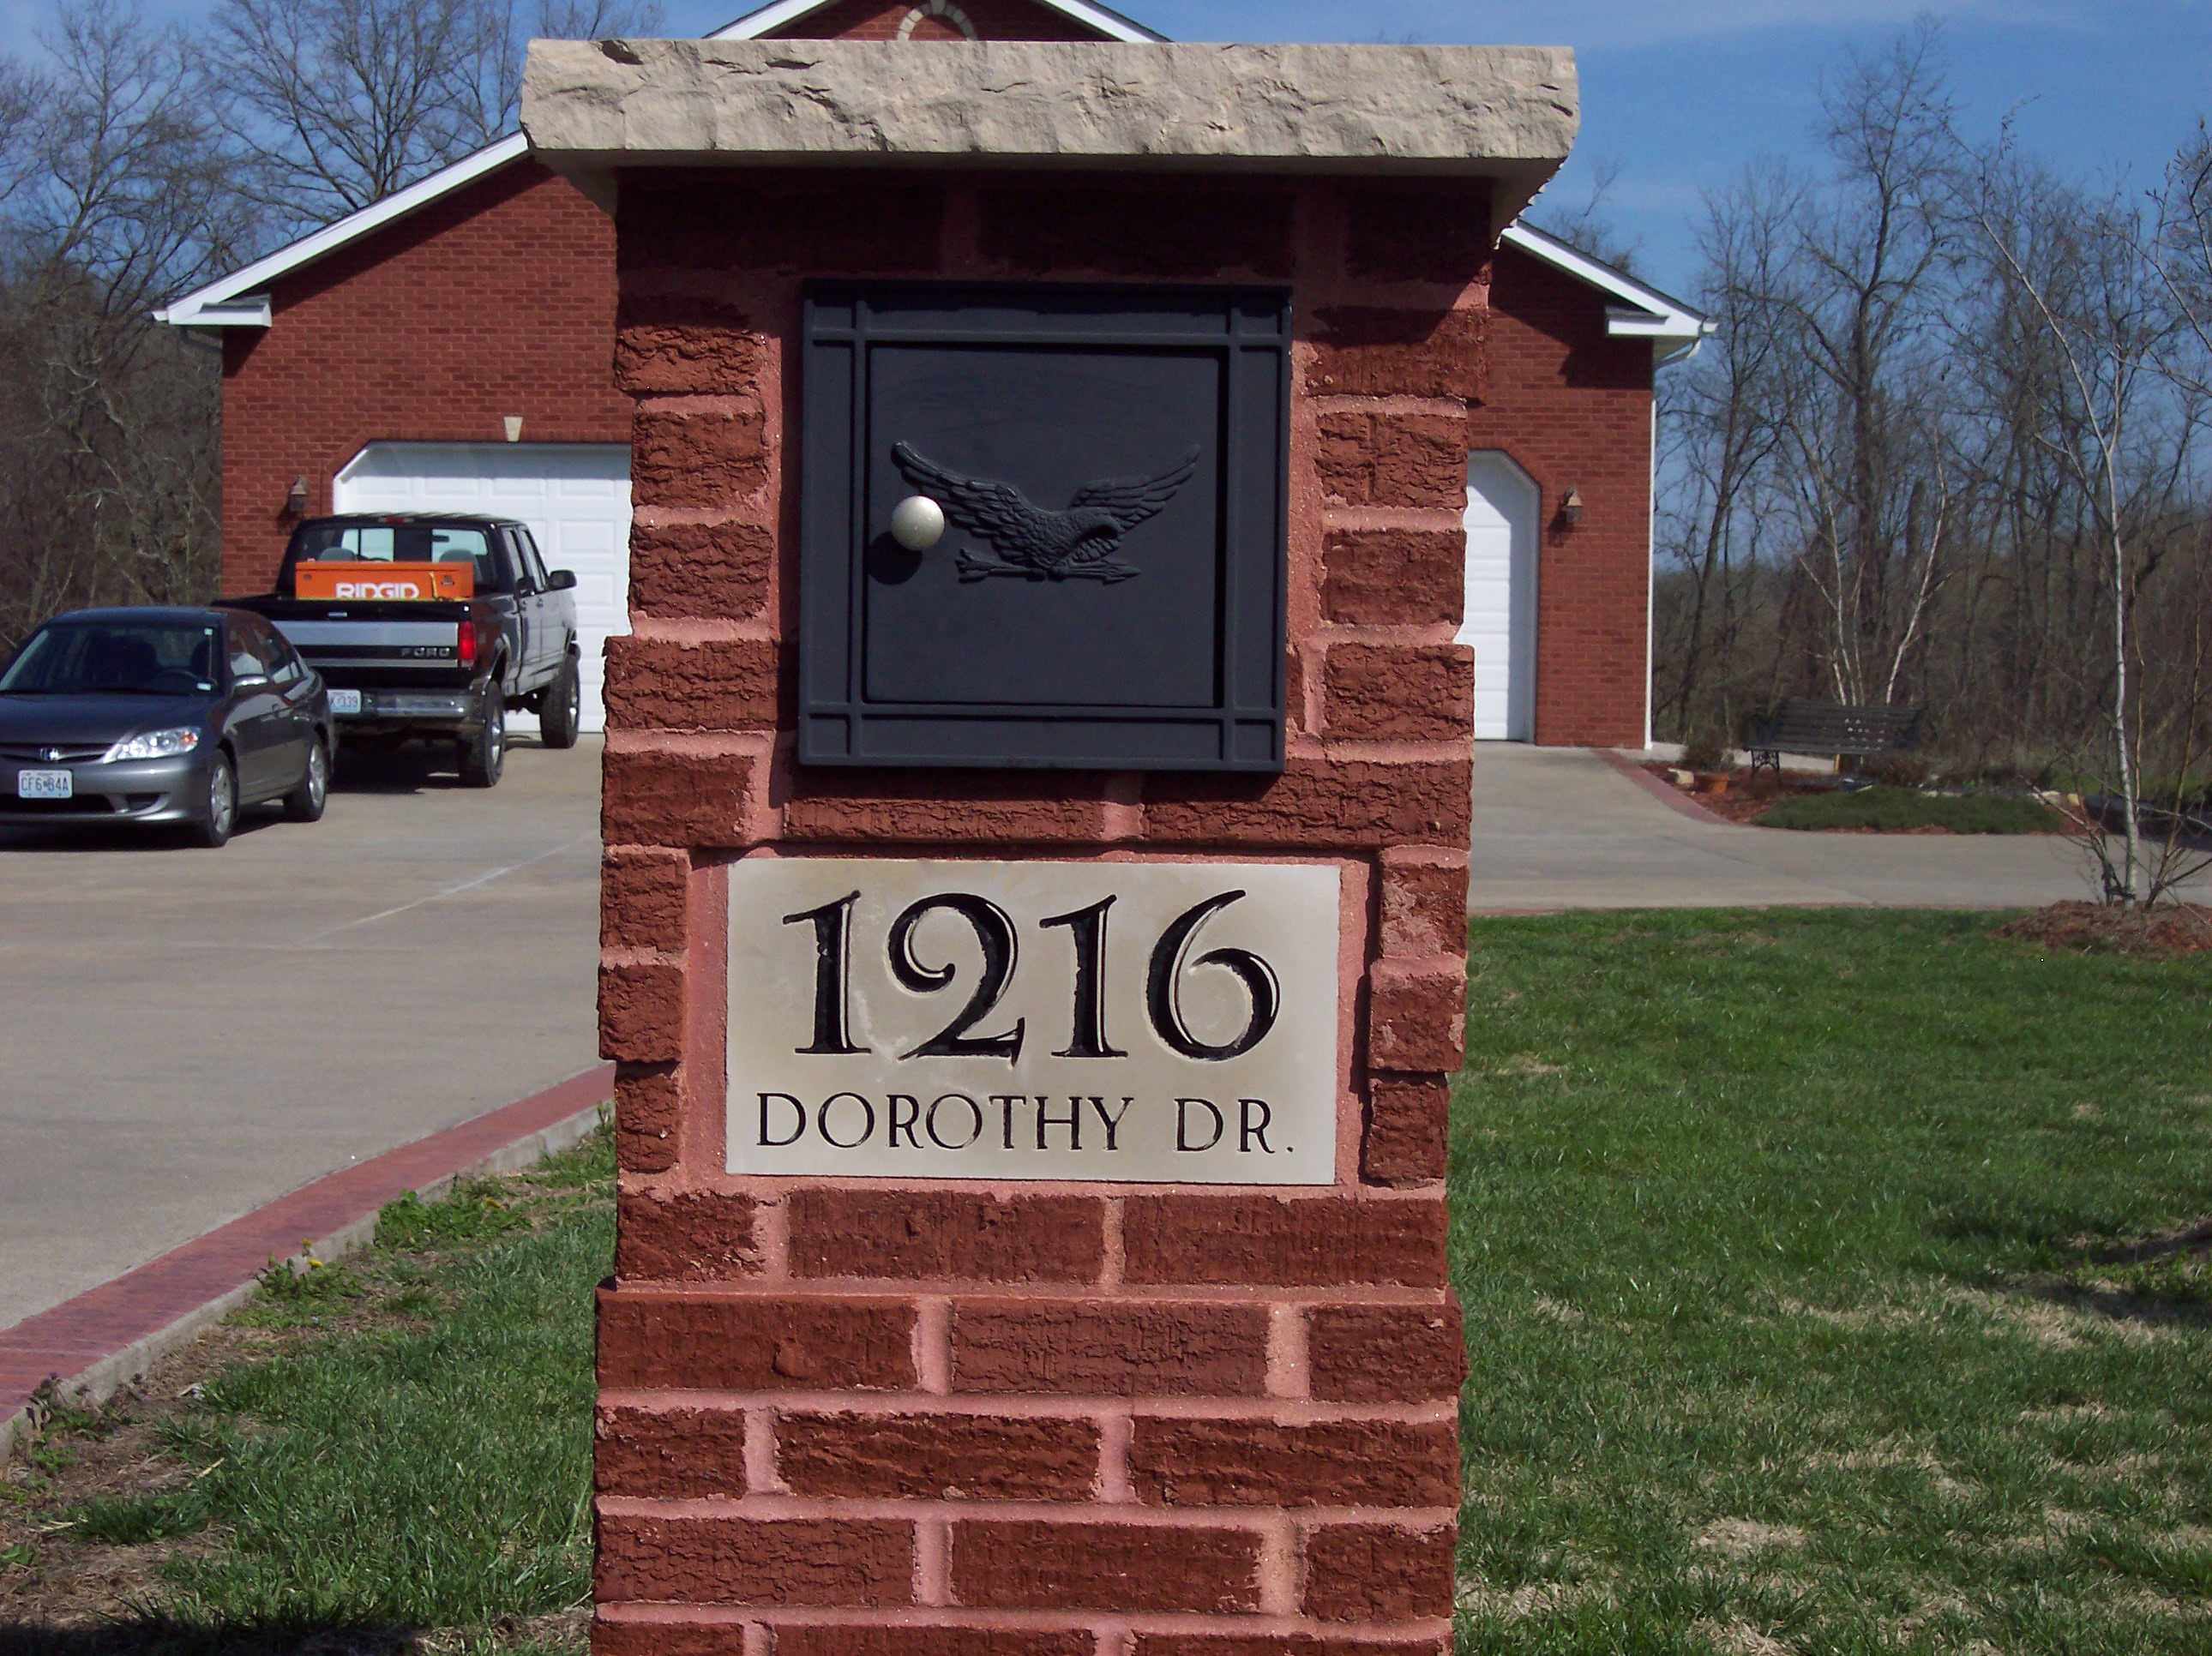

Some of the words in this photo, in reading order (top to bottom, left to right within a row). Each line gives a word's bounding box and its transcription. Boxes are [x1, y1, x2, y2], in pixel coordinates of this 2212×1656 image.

[335, 582, 419, 598] RIDGID
[401, 647, 450, 658] FORD
[782, 888, 1281, 1068] 1216
[755, 1091, 1135, 1152] DOROTHY
[1173, 1097, 1295, 1155] DR.
